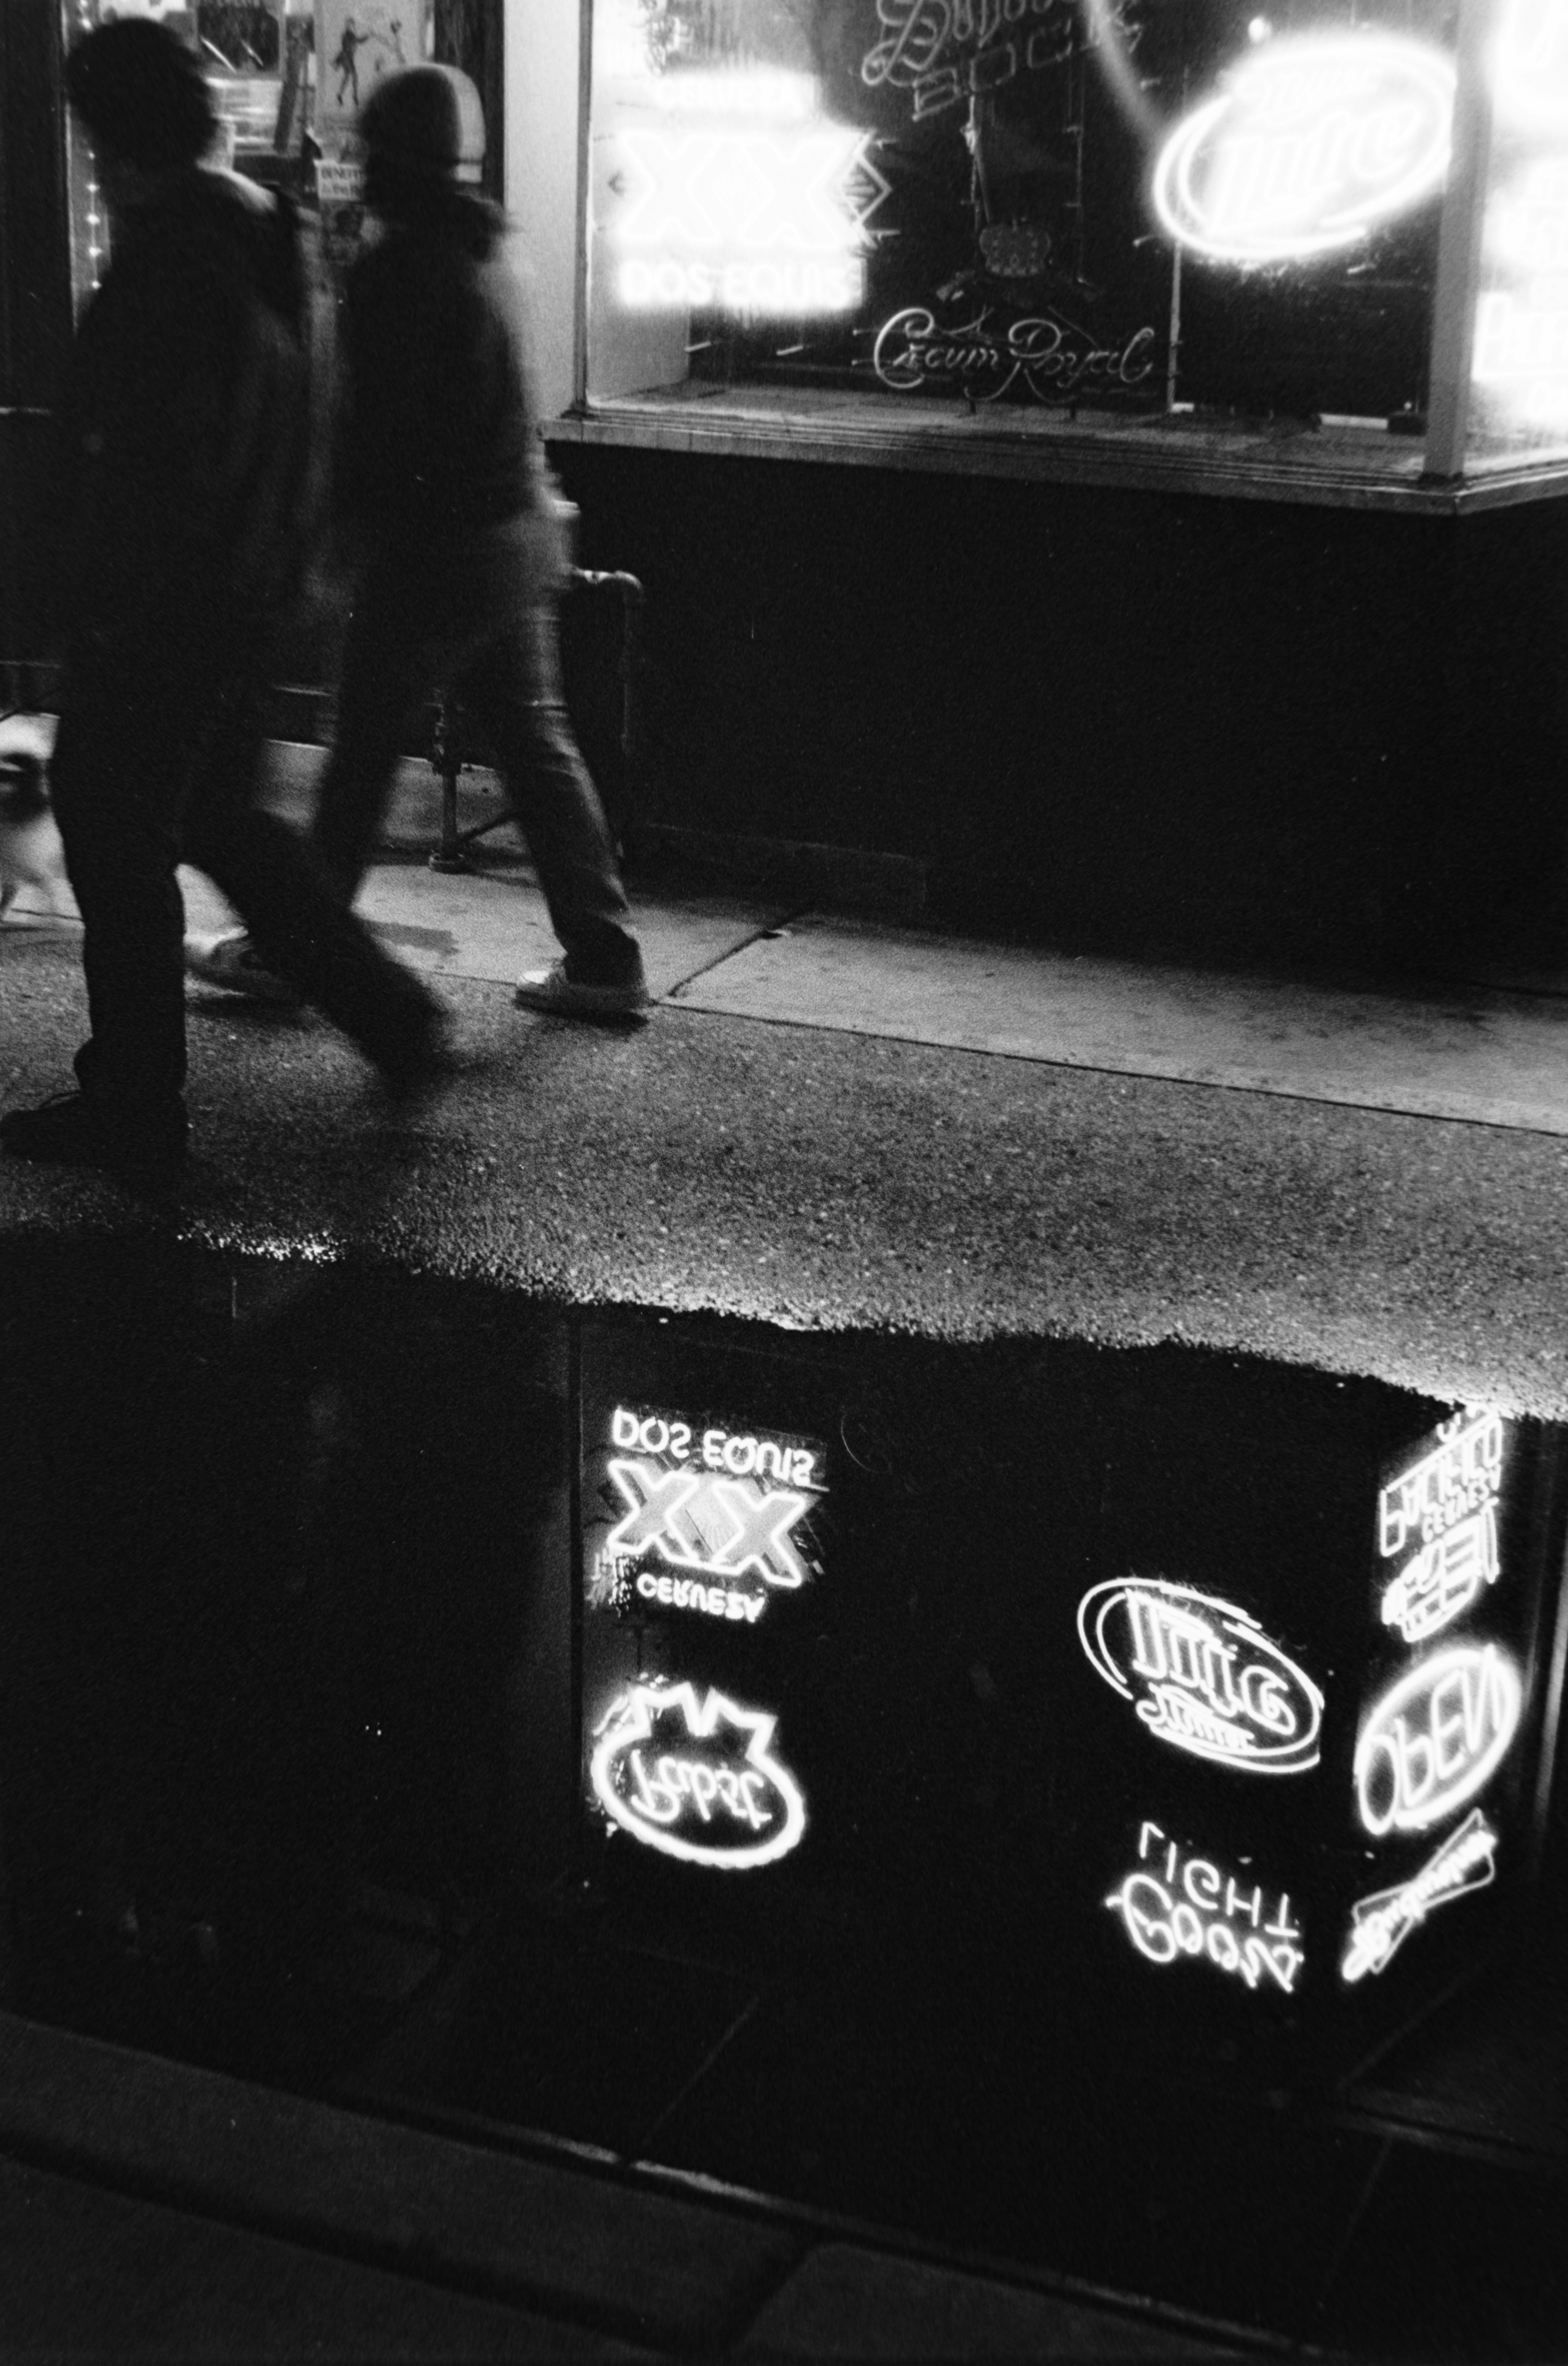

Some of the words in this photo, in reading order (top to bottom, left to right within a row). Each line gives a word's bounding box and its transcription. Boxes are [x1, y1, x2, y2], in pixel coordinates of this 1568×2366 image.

[621, 259, 711, 303] DOS
[722, 260, 849, 308] EQUIS
[874, 308, 999, 389] Crown
[965, 318, 1154, 403] Royal
